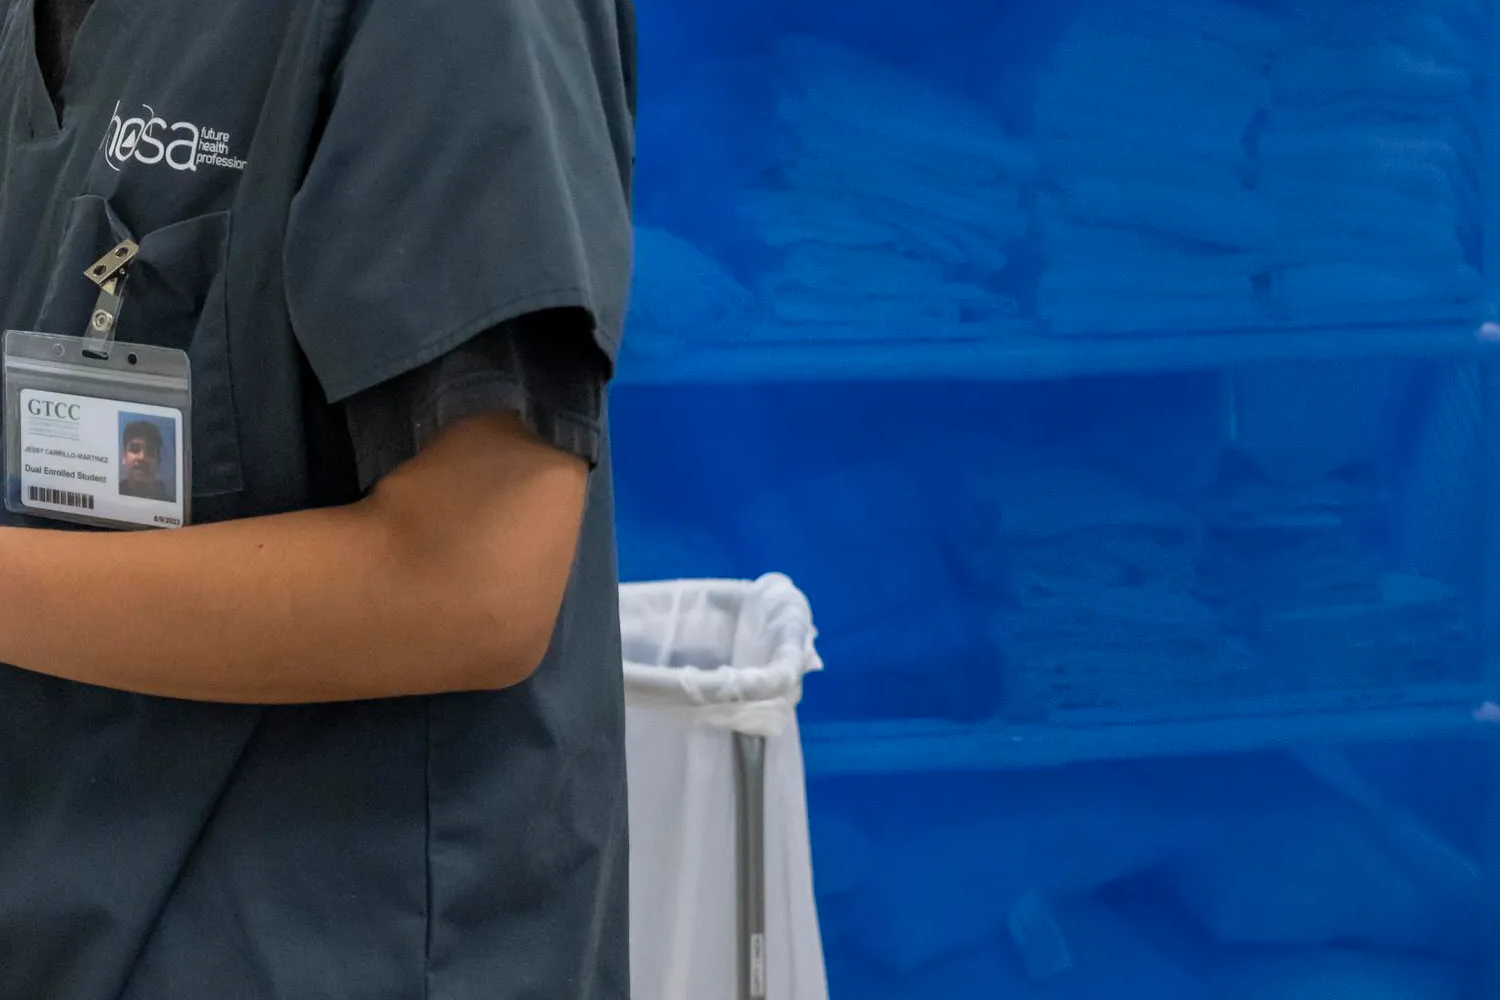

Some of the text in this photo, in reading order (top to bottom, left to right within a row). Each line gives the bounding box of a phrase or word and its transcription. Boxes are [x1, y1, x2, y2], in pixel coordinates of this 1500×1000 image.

[100, 100, 199, 171] hosa
[201, 126, 230, 142] future
[198, 138, 229, 154] health
[27, 398, 81, 420] GTCC
[24, 464, 107, 483] Dual Enrolled Student
